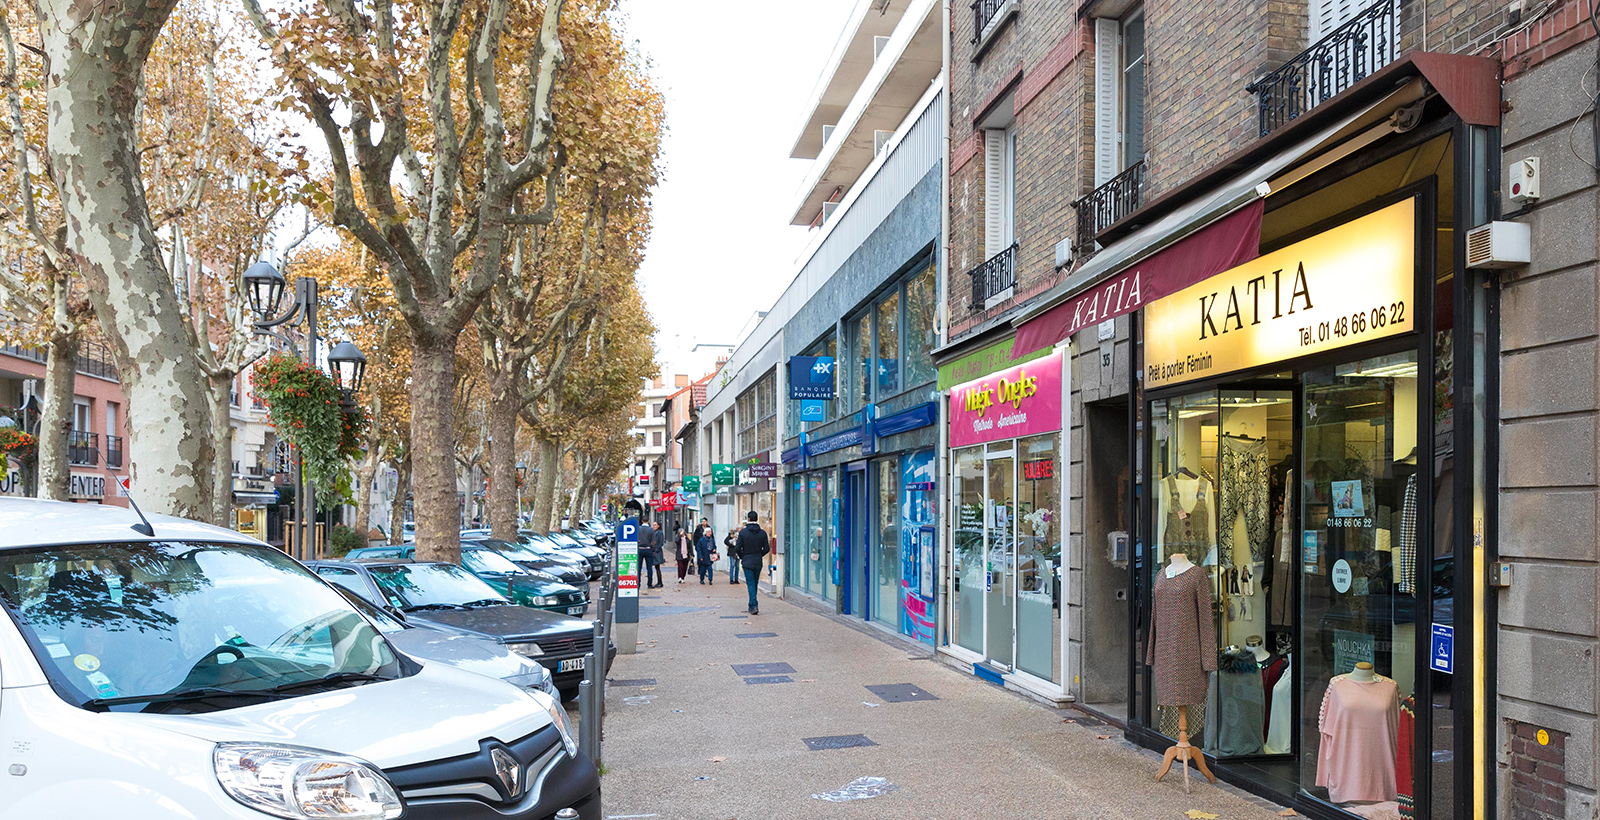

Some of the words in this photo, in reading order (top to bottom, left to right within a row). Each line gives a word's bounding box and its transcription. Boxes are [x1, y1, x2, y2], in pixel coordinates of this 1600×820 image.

[1068, 270, 1142, 332] KATIA
[1198, 260, 1314, 341] KATIA
[1299, 327, 1316, 347] Tél.
[1318, 320, 1331, 342] 01
[1334, 316, 1348, 338] 48
[1351, 311, 1366, 335] 66
[1370, 305, 1387, 330] 06
[1390, 300, 1405, 326] 22
[1102, 352, 1111, 367] 35
[1166, 357, 1186, 381] porter
[1186, 351, 1213, 374] Féminin
[965, 383, 994, 417] Magic
[997, 370, 1037, 409] Ongles
[71, 475, 105, 495] ENTER
[623, 524, 636, 540] P
[1344, 518, 1352, 527] 66
[1353, 518, 1362, 527] 06
[1363, 518, 1372, 527] 22
[1337, 638, 1372, 656] NOUCHKA
